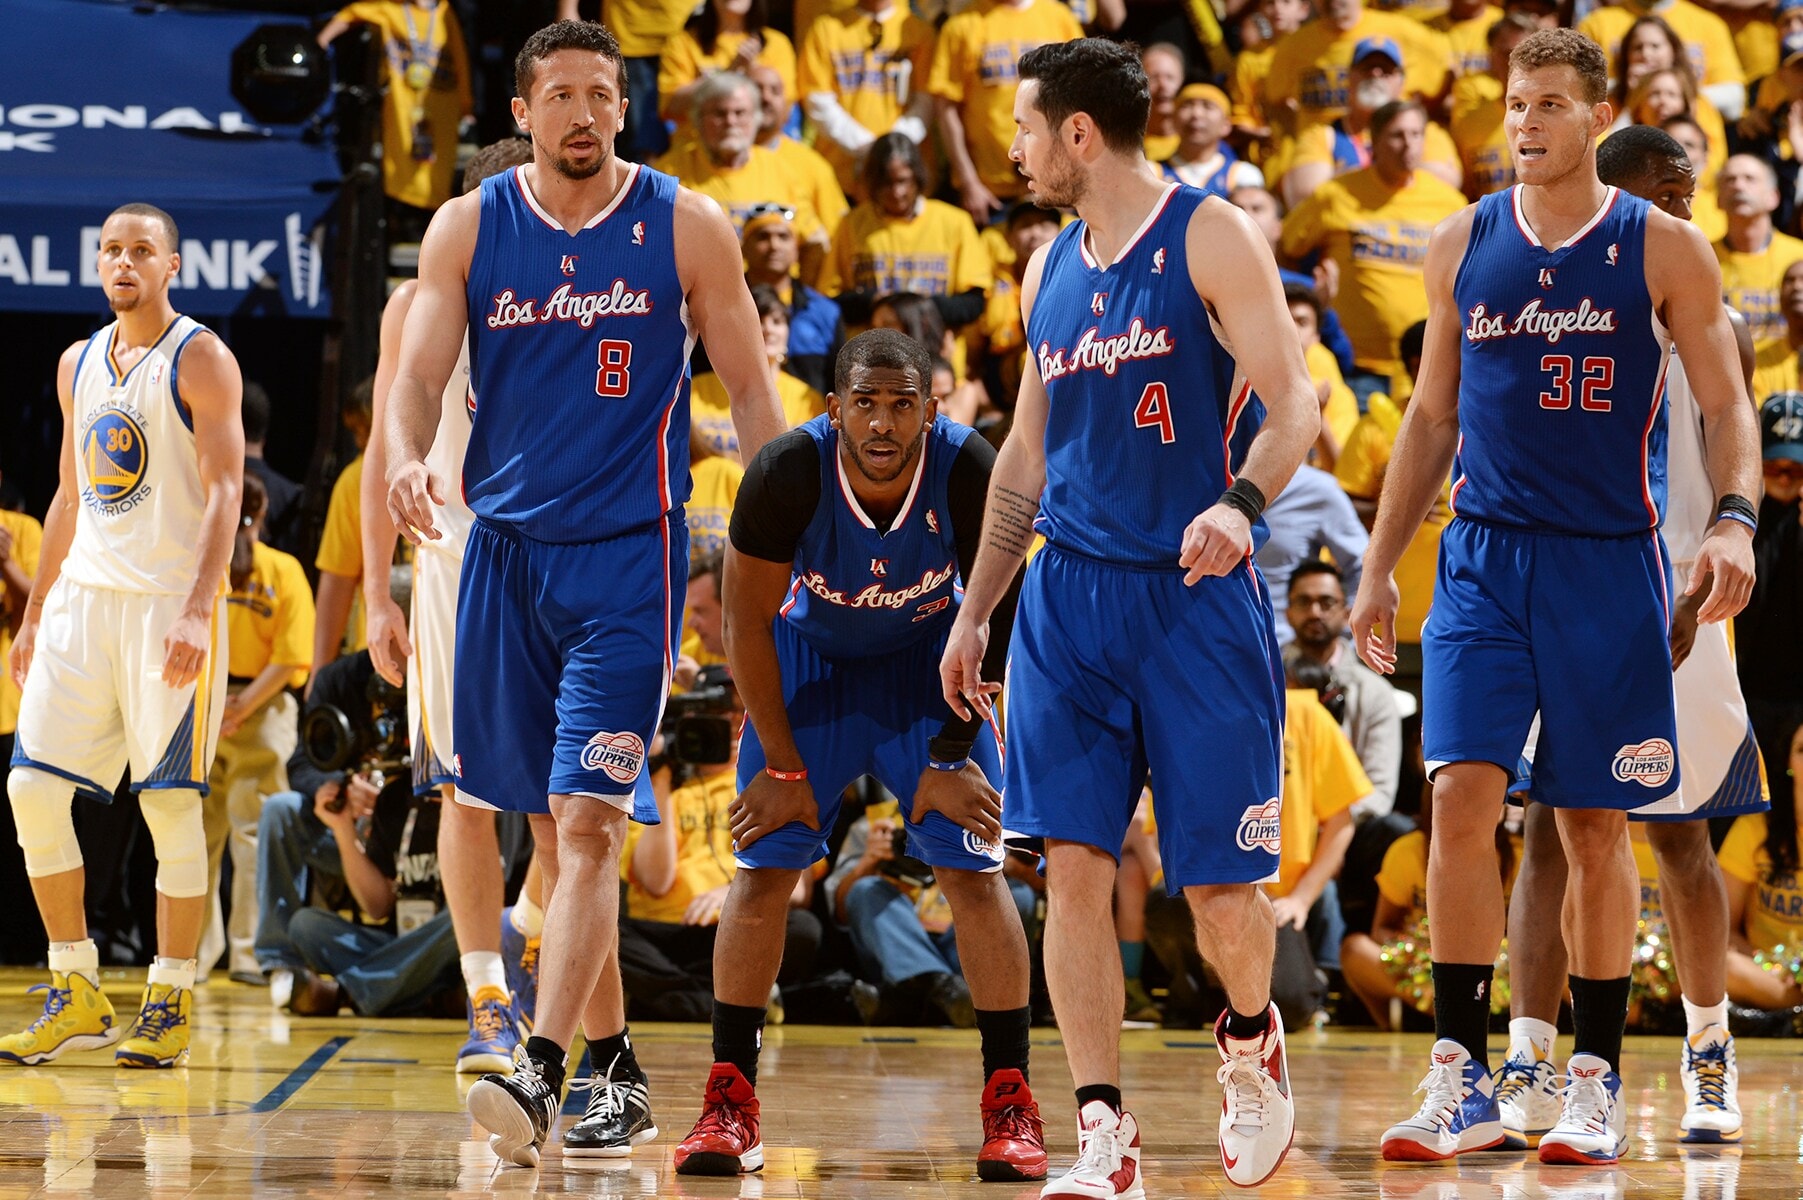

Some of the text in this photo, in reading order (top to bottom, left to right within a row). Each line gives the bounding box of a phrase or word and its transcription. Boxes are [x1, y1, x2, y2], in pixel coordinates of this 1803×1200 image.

[0, 103, 272, 134] ONAL
[80, 226, 279, 290] BNK
[487, 278, 654, 330] Los Angeles
[1466, 296, 1619, 346] Los Angeles
[595, 339, 632, 398] 8
[1037, 316, 1175, 385] Los Angeles
[1539, 354, 1615, 412] 32
[81, 400, 149, 430] GOLDEN STATE
[1133, 381, 1176, 444] 4
[106, 427, 133, 452] 30
[82, 483, 152, 517] WARRIORS
[802, 561, 954, 609] Los Angeles
[584, 744, 640, 772] CLIPPERS
[1615, 757, 1669, 779] CLIPPERS
